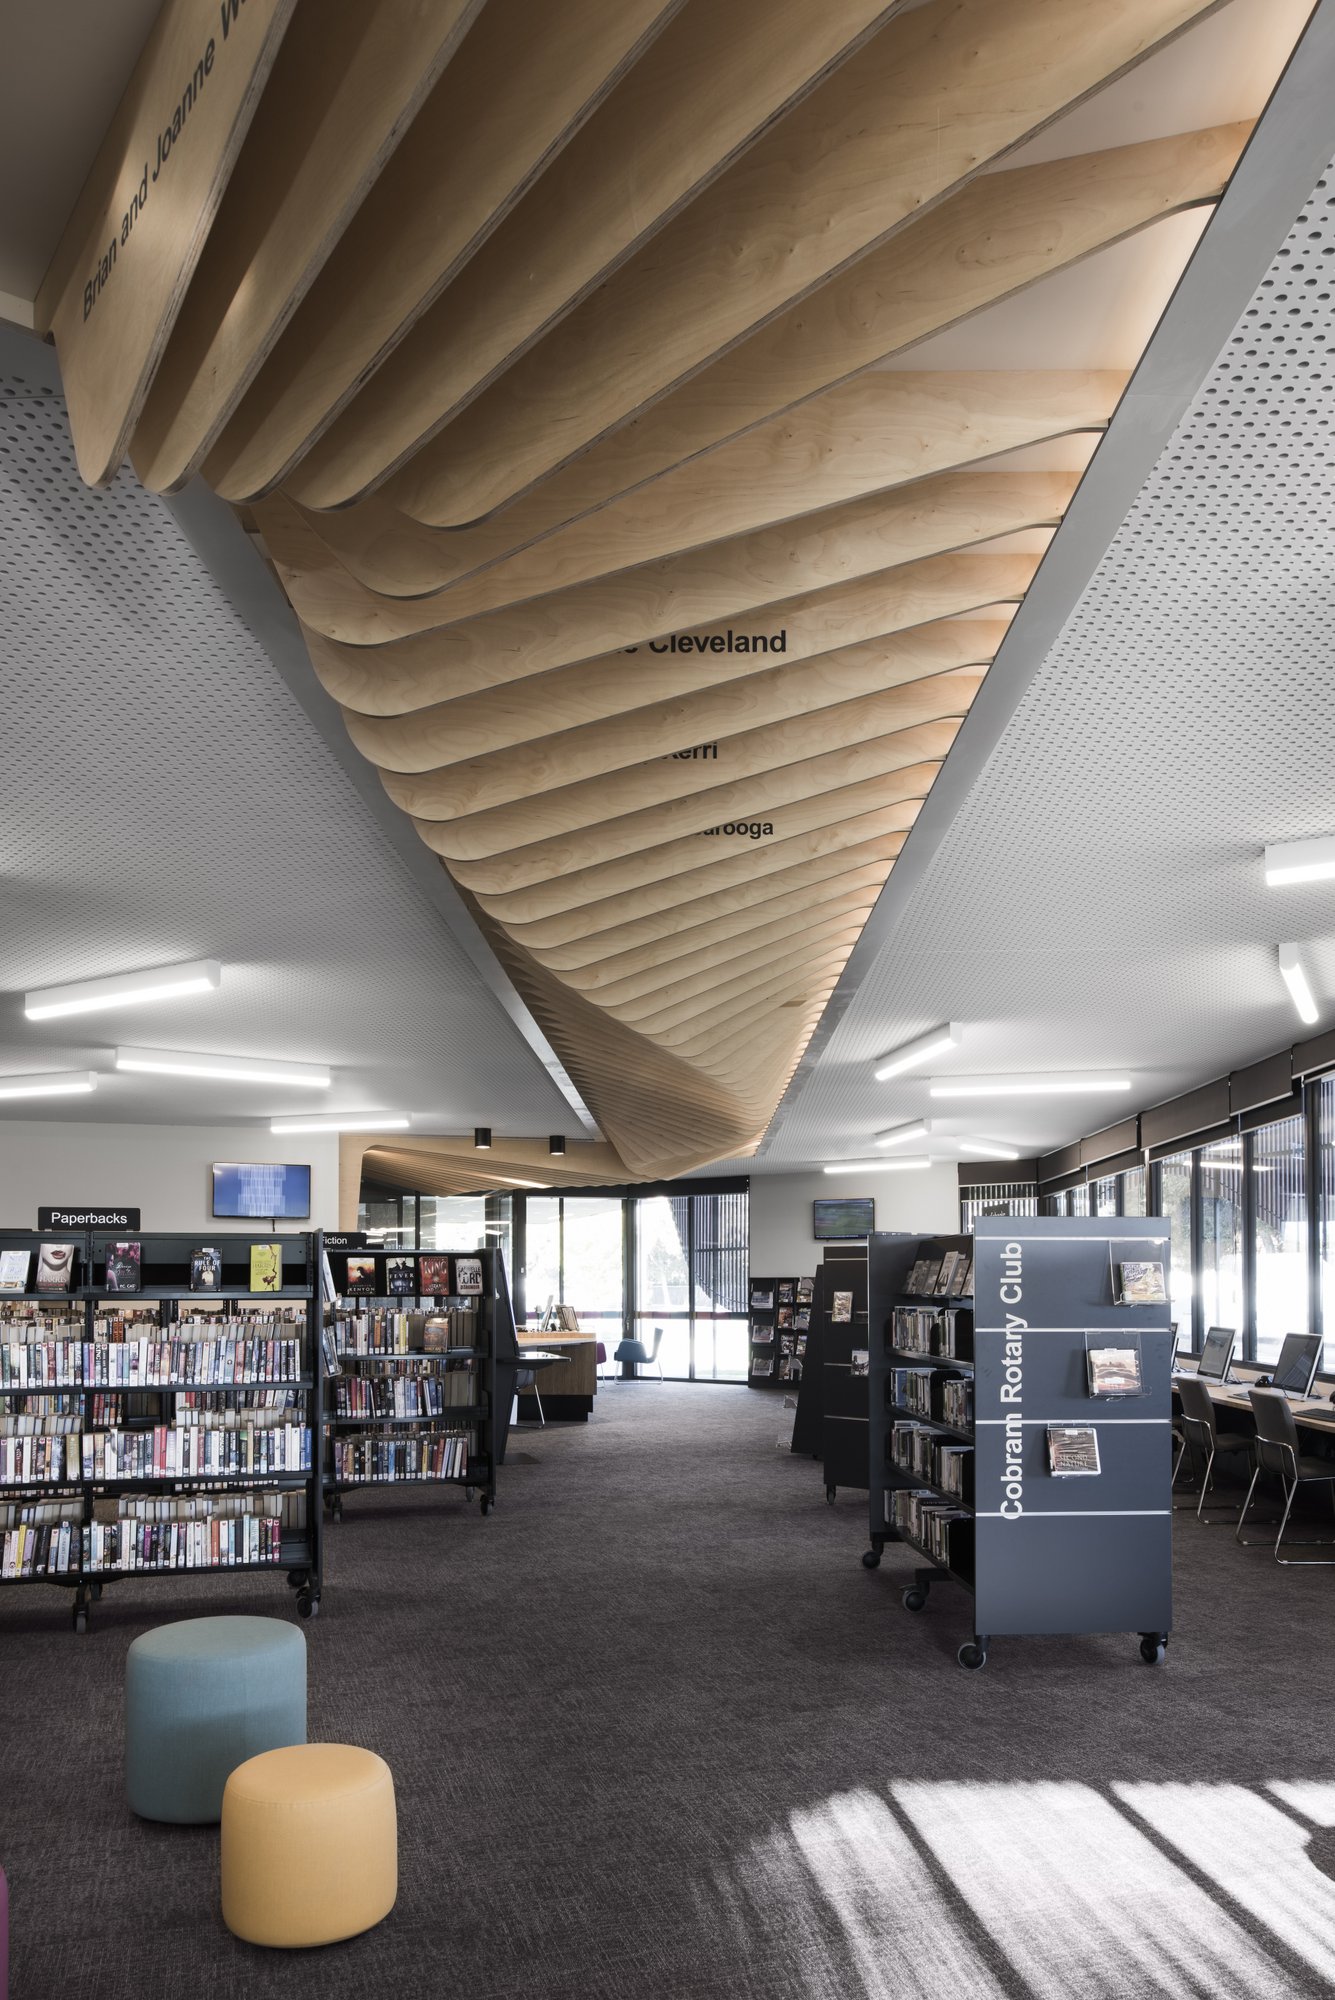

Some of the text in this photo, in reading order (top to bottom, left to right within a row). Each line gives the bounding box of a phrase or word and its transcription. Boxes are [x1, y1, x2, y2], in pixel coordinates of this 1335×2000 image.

[83, 0, 247, 323] Brian and Joanne W
[696, 822, 774, 840] arooga
[51, 1212, 128, 1226] Paperbacks
[424, 1261, 448, 1275] KING
[1000, 1242, 1028, 1520] Cobram Rotary Club
